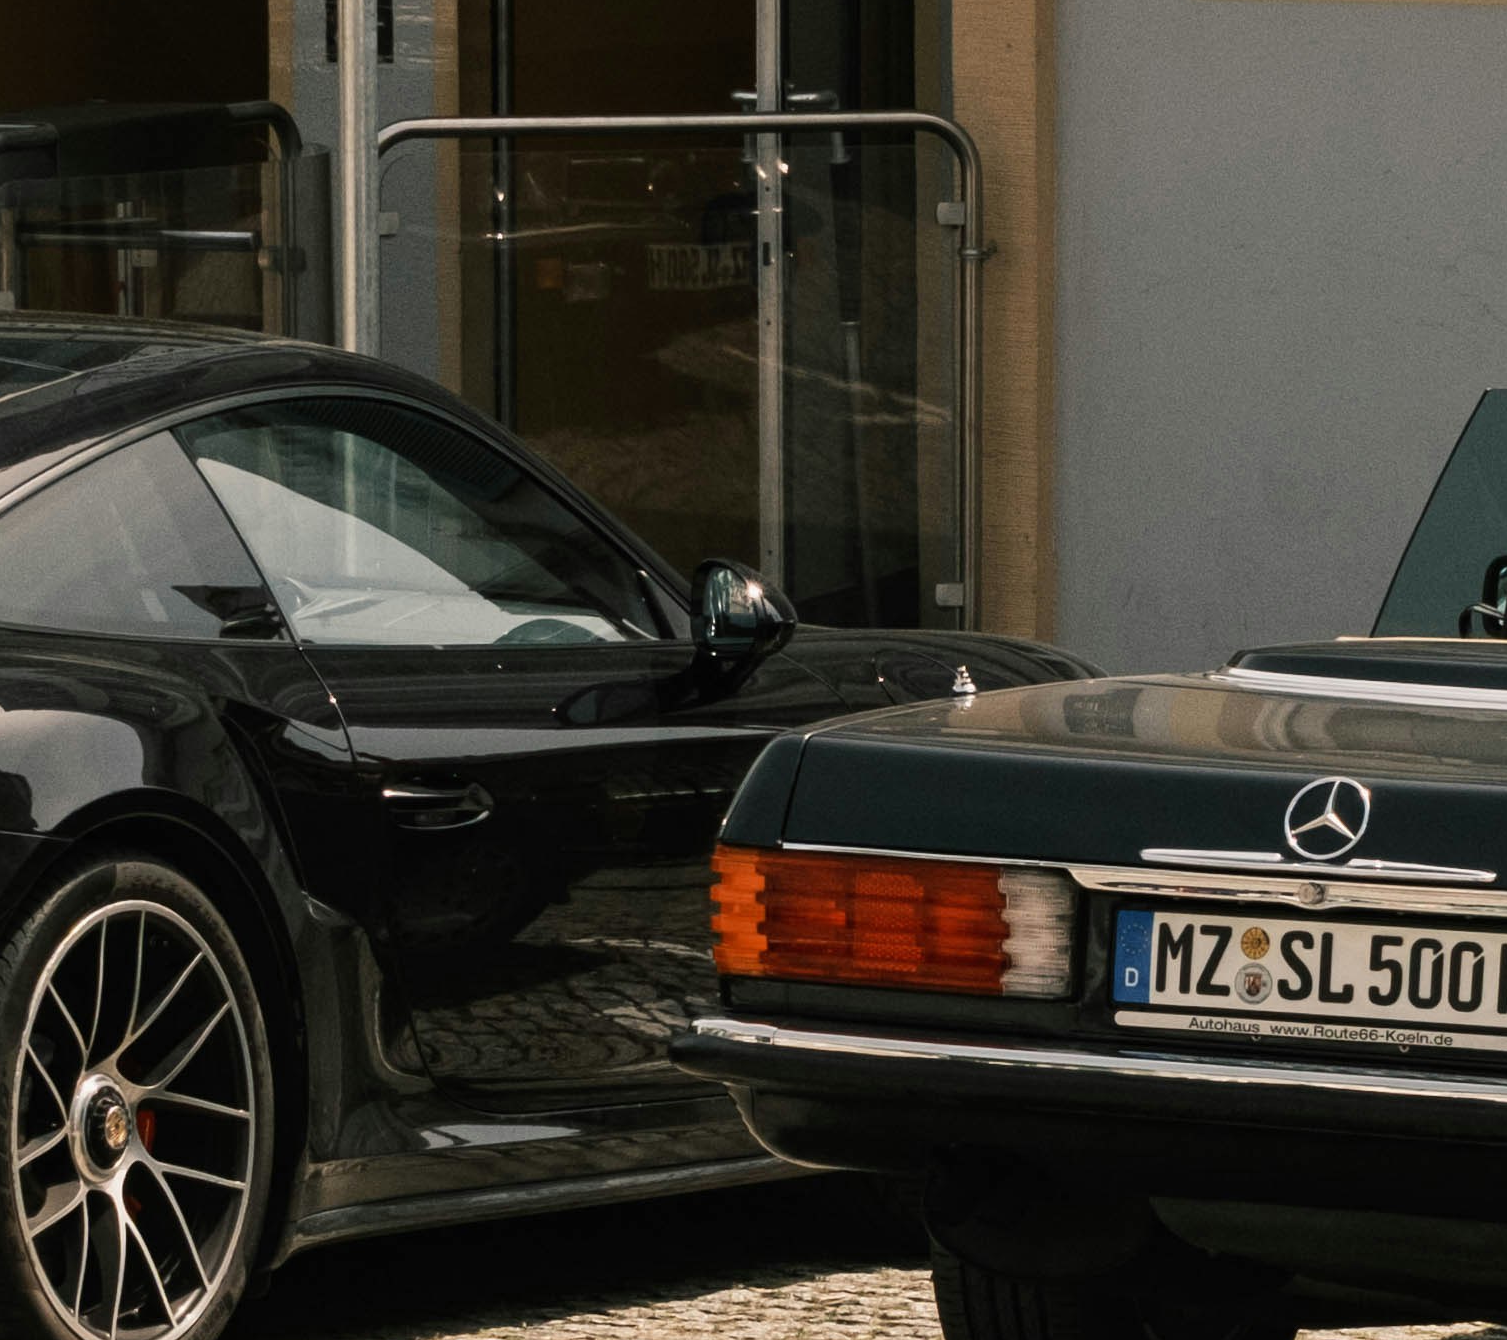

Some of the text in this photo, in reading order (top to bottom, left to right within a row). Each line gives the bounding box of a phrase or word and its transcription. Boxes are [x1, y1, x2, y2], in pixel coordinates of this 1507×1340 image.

[1124, 967, 1139, 987] D
[1155, 921, 1233, 997] MZ
[1277, 930, 1354, 1004] SL
[1189, 1016, 1454, 1047] Autohaus www.Route66-Koeln.de
